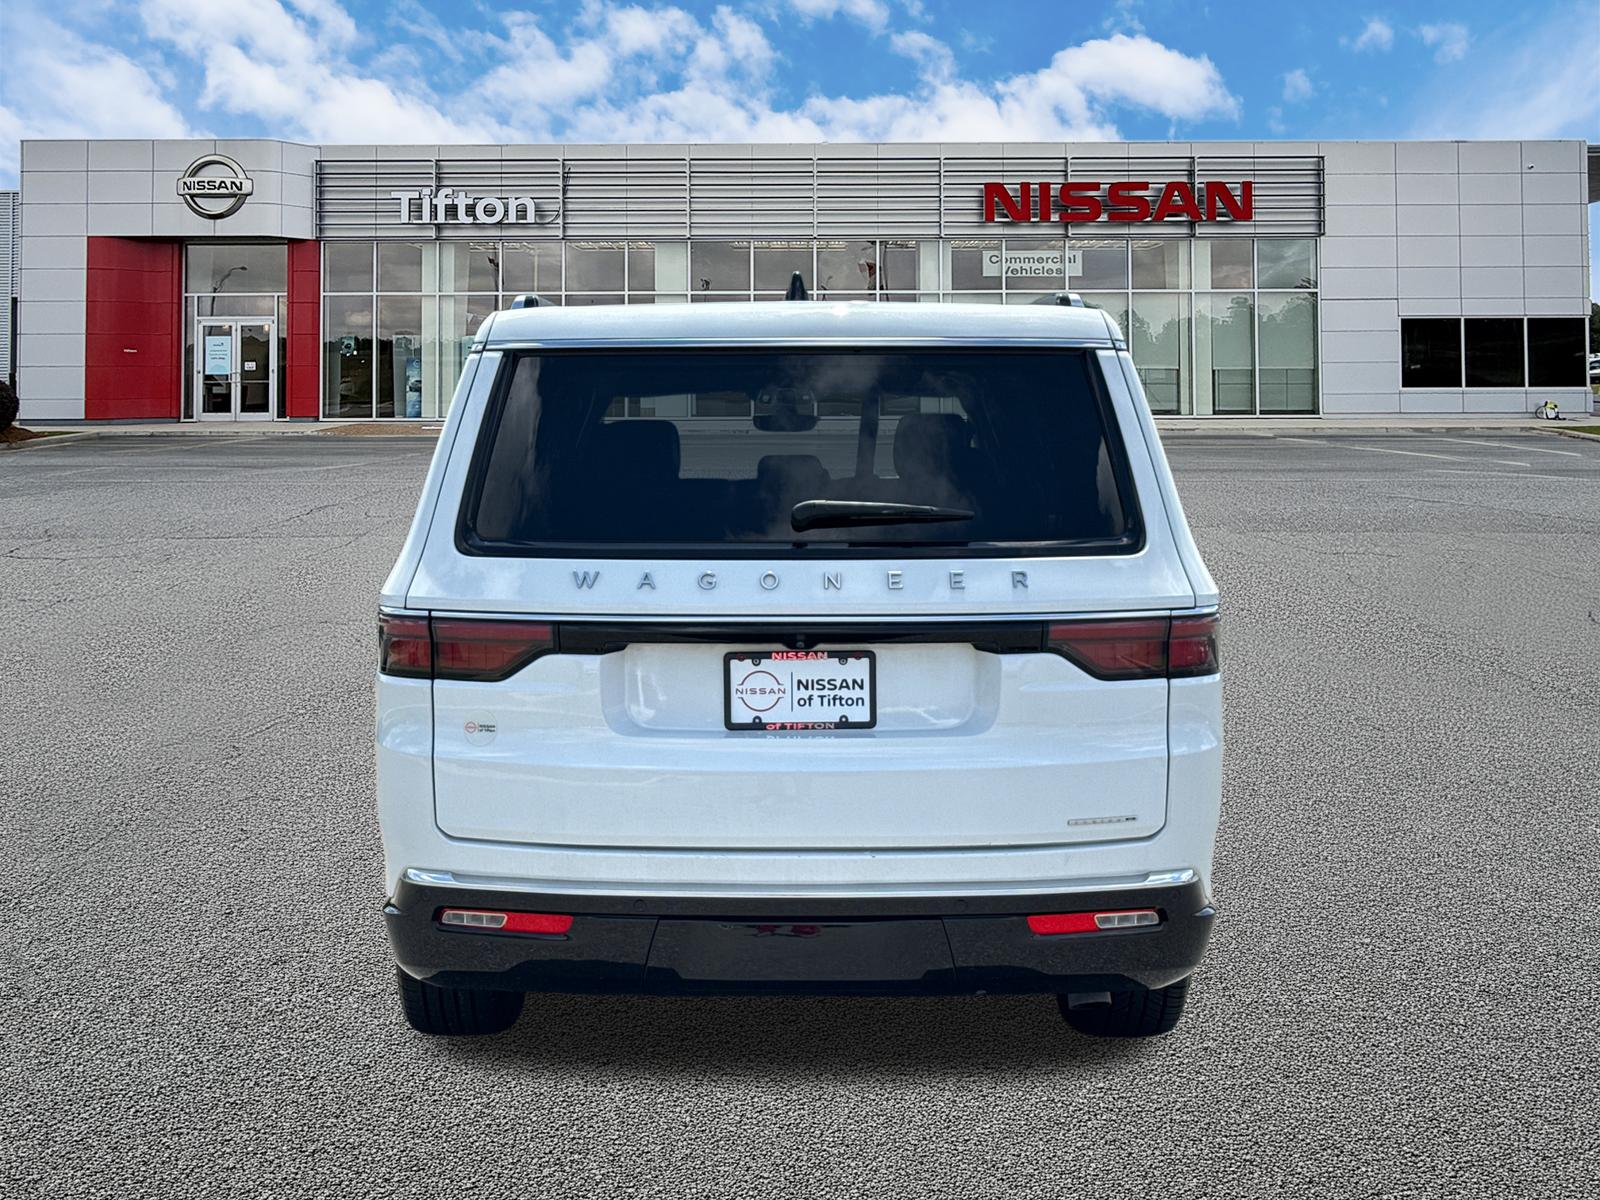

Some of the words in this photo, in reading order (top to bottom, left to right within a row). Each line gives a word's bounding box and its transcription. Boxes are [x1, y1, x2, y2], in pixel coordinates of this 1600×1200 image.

[182, 180, 243, 191] NISSAN
[391, 188, 536, 224] Tifton
[983, 181, 1253, 222] NISSAN
[572, 570, 1029, 590] WAGONEER
[771, 651, 828, 661] NISSAN
[735, 687, 786, 695] NISSAN
[796, 678, 864, 691] NISSAN
[797, 694, 814, 707] of
[818, 694, 865, 707] Tifton
[765, 723, 782, 731] of
